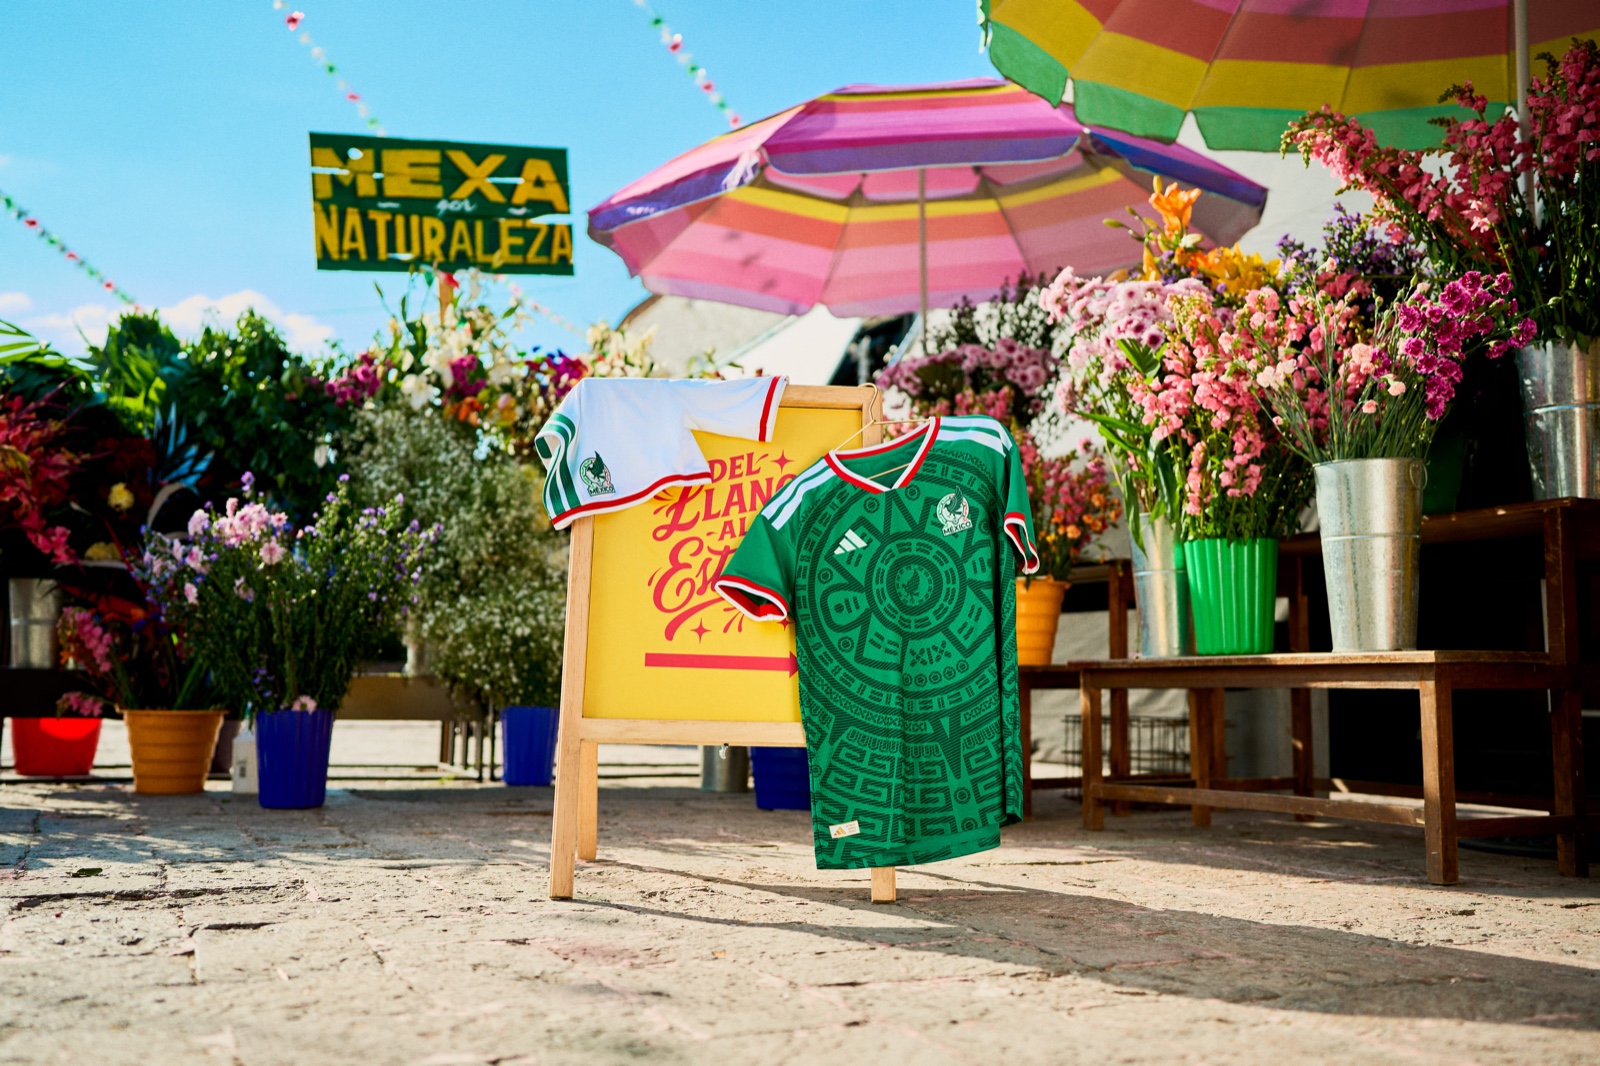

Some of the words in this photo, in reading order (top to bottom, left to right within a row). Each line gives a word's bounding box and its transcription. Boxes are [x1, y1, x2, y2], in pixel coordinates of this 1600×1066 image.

[312, 147, 570, 212] MEXA
[313, 200, 573, 265] NATURALEZA
[708, 451, 761, 484] DEL
